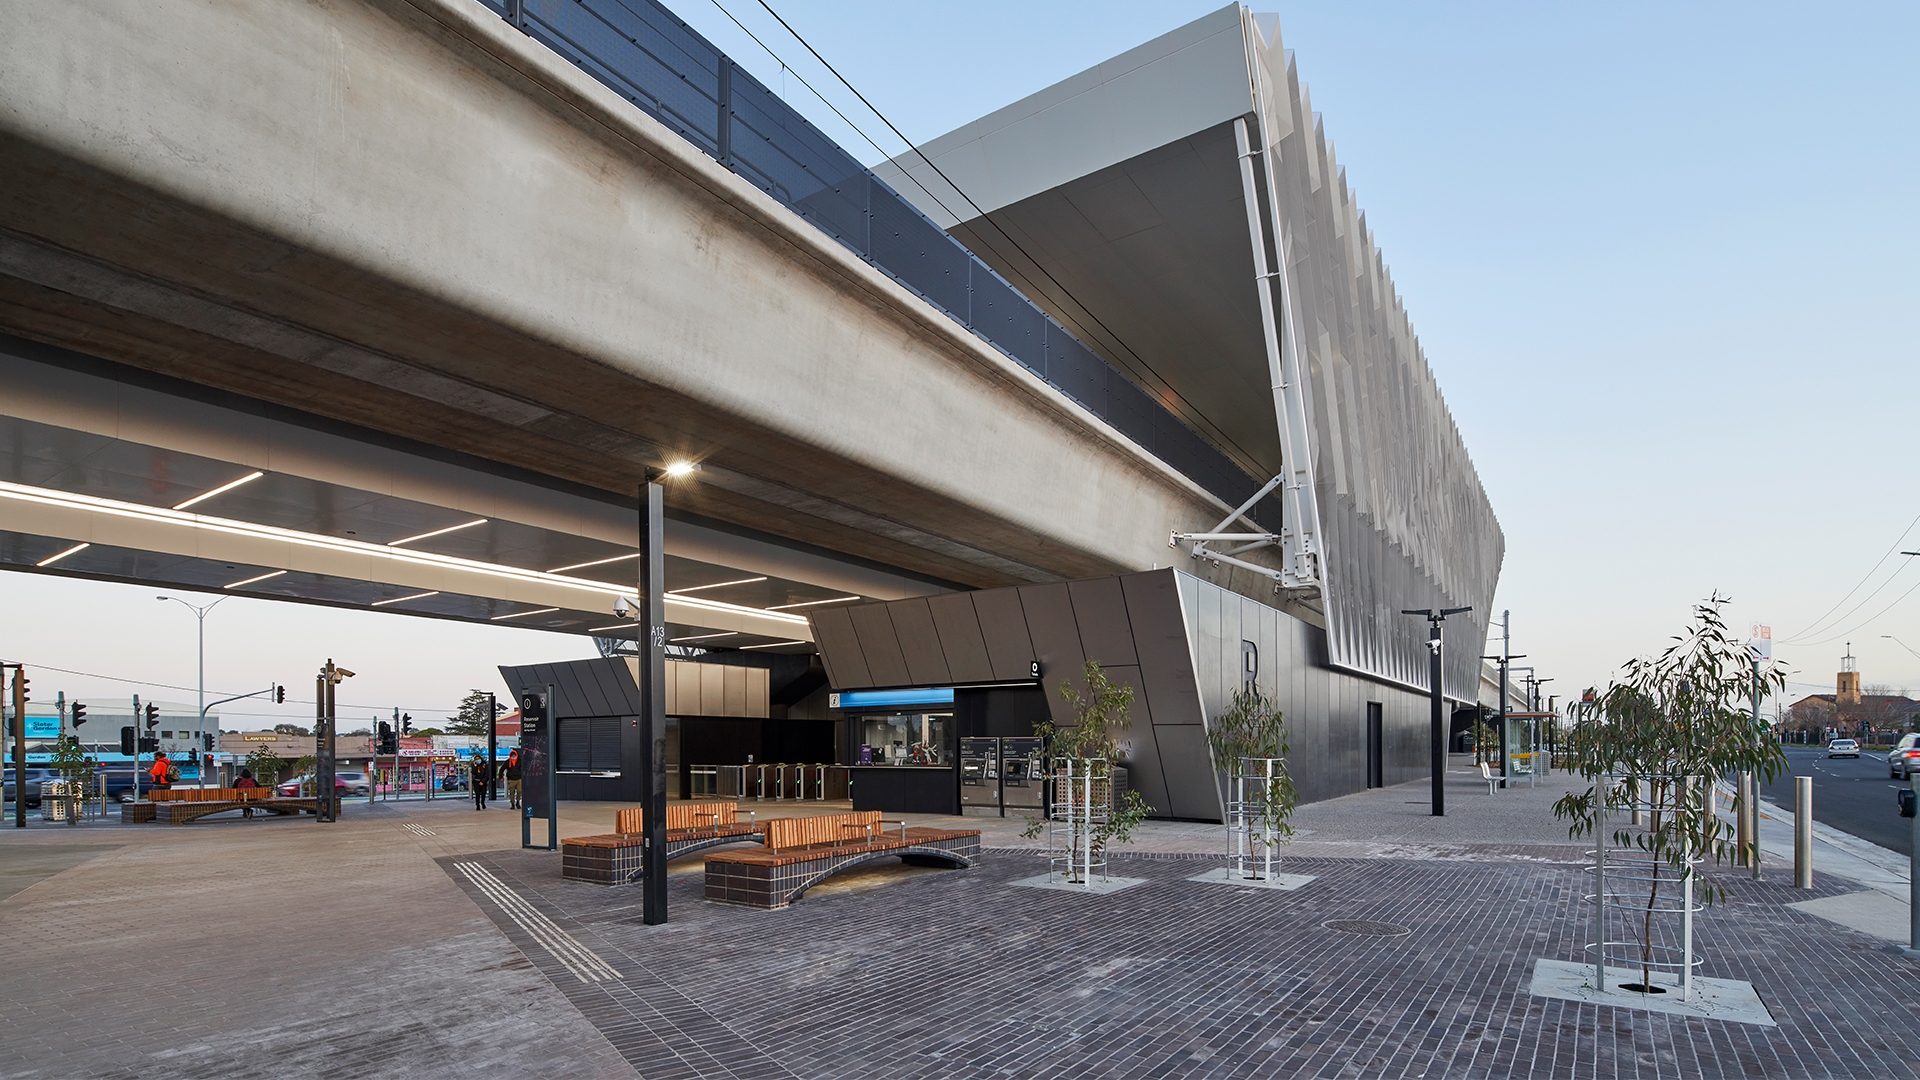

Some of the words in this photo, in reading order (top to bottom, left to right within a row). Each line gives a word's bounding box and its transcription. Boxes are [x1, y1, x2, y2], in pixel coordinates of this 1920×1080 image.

[651, 625, 665, 637] A13
[653, 636, 663, 647] /2
[1242, 638, 1259, 706] R
